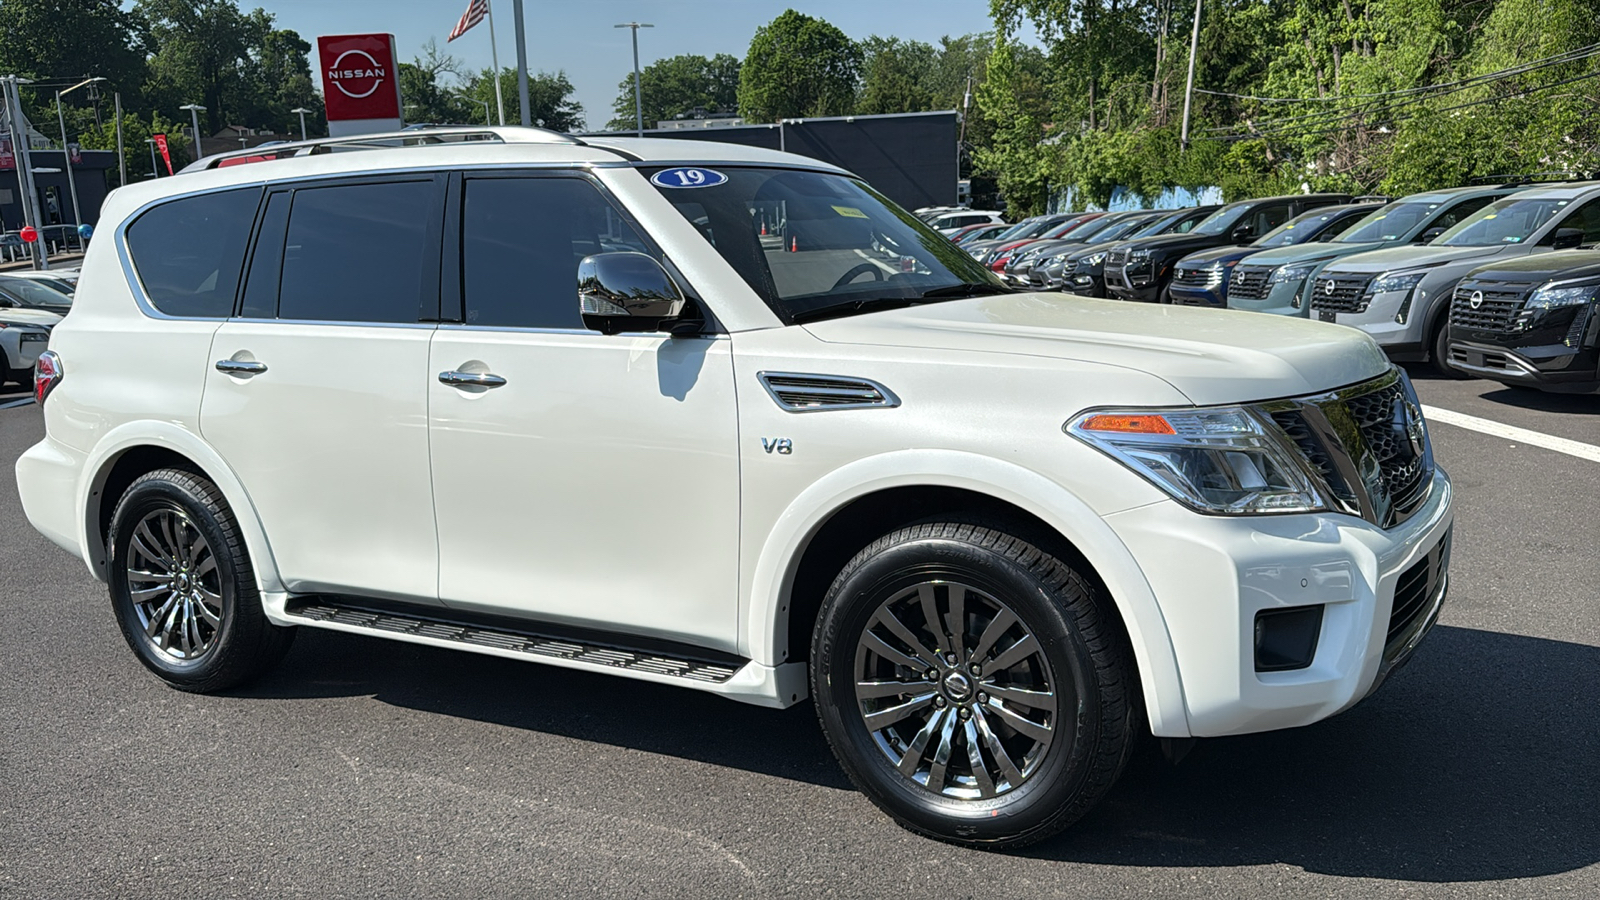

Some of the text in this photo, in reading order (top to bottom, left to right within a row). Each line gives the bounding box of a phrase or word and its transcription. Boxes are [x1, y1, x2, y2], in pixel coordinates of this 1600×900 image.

[328, 68, 385, 79] NISSAN
[674, 169, 706, 186] 19
[760, 437, 793, 455] V8
